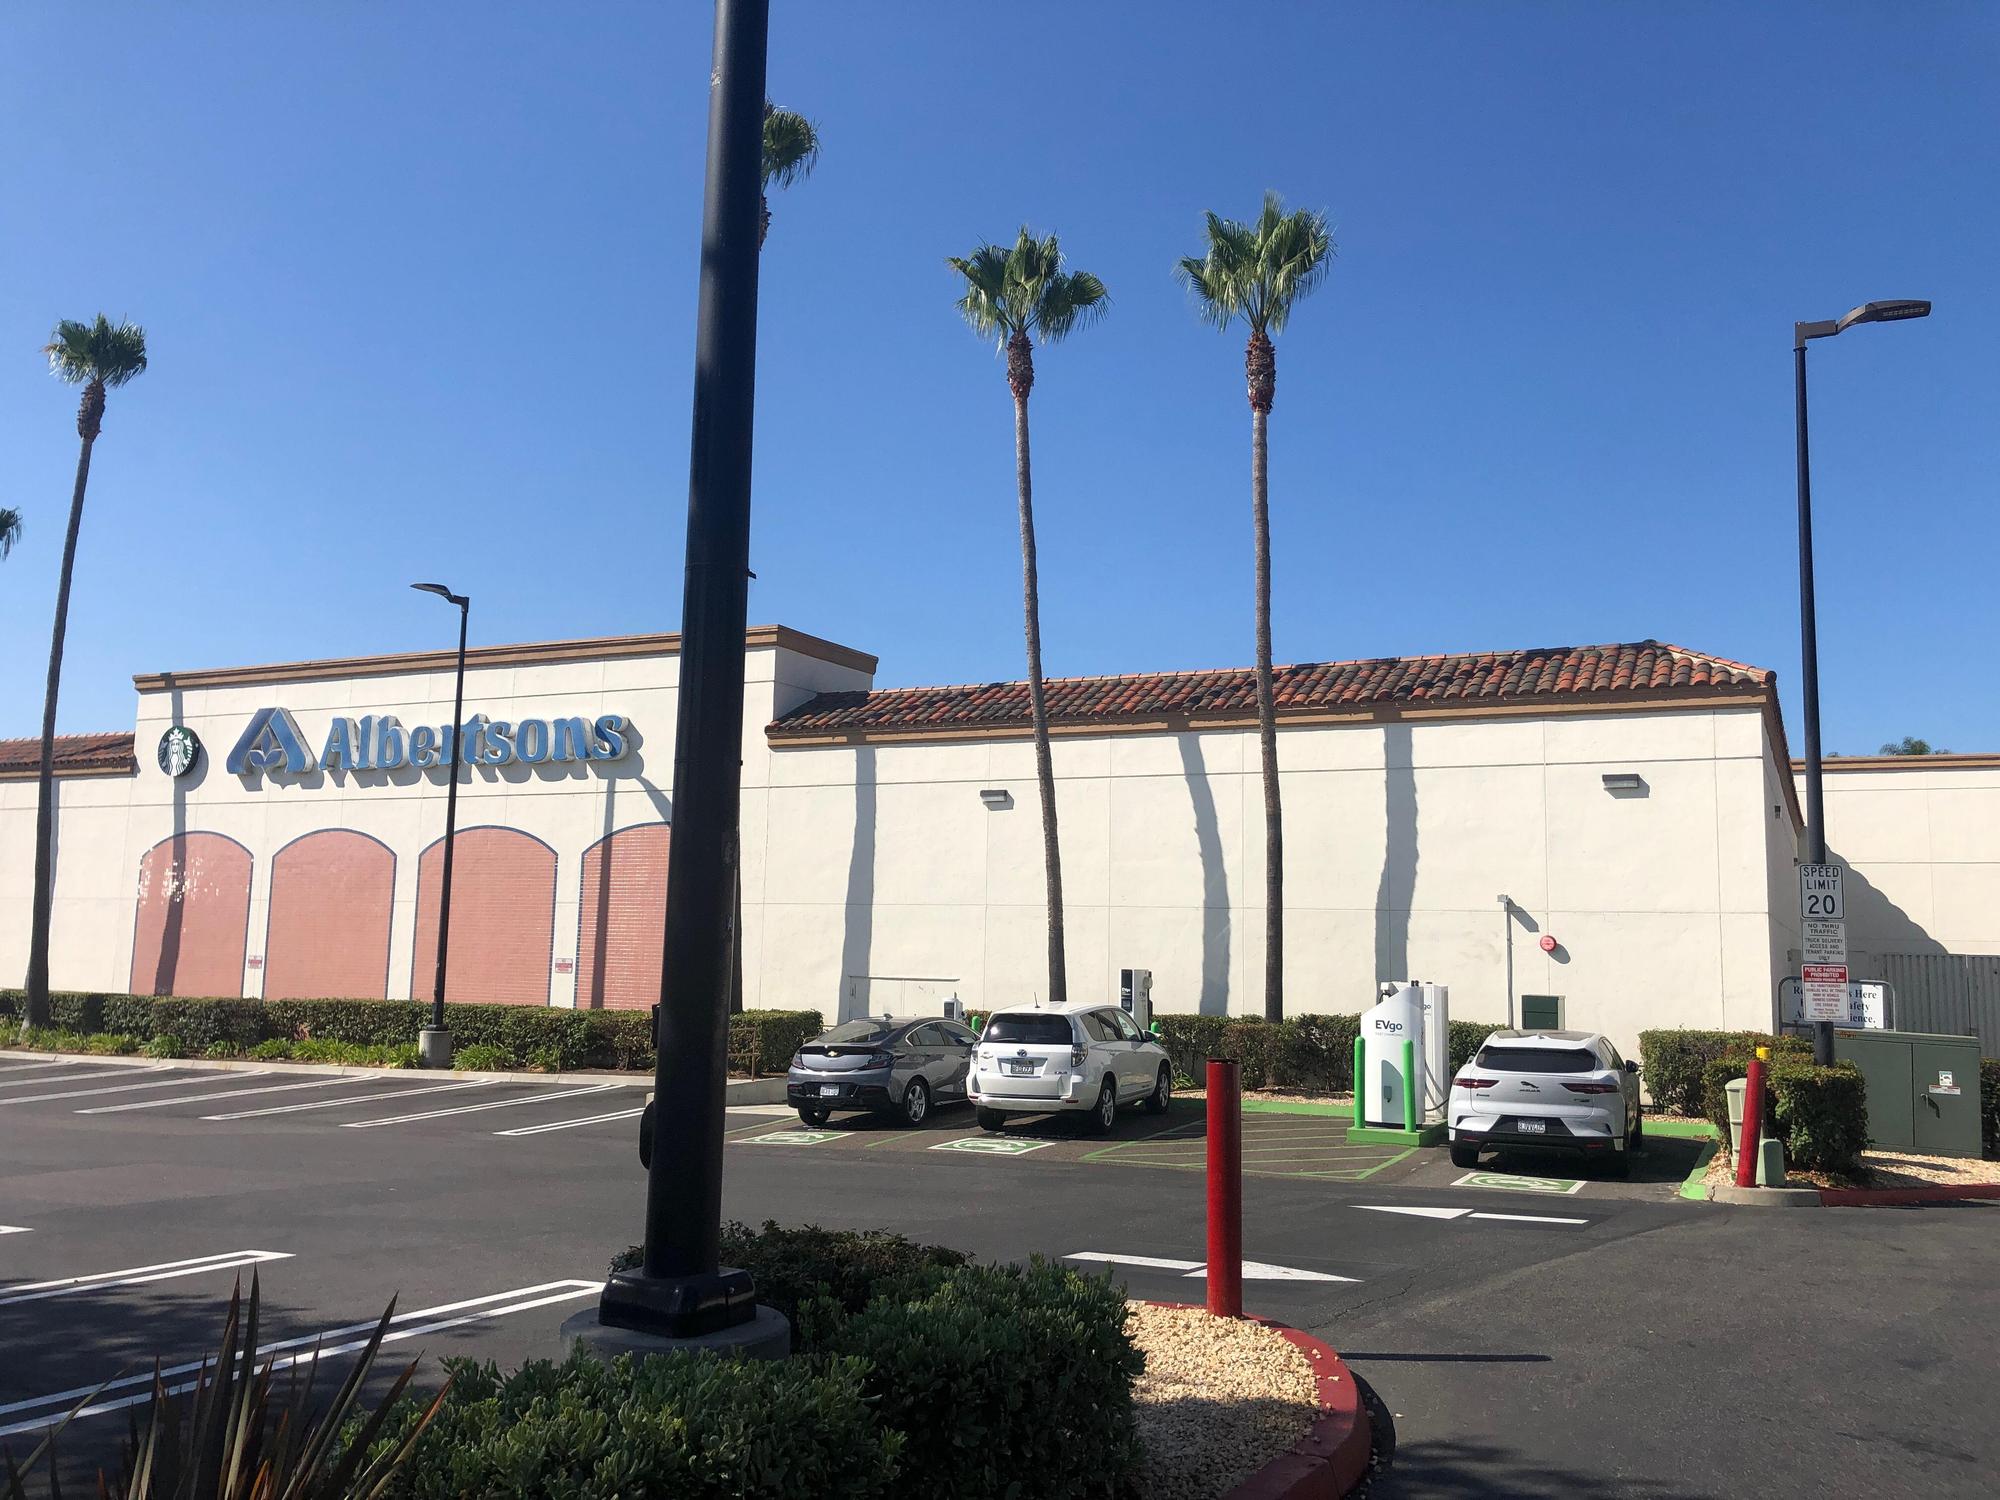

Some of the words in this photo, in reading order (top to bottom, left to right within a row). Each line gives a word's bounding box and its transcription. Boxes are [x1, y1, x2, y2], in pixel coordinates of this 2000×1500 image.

[319, 713, 628, 771] Albertsons
[1803, 866, 1839, 877] SPEED
[1806, 879, 1837, 890] LIMIT
[1808, 895, 1835, 914] 20
[1855, 989, 1877, 998] Here
[1375, 1019, 1403, 1033] EVgo
